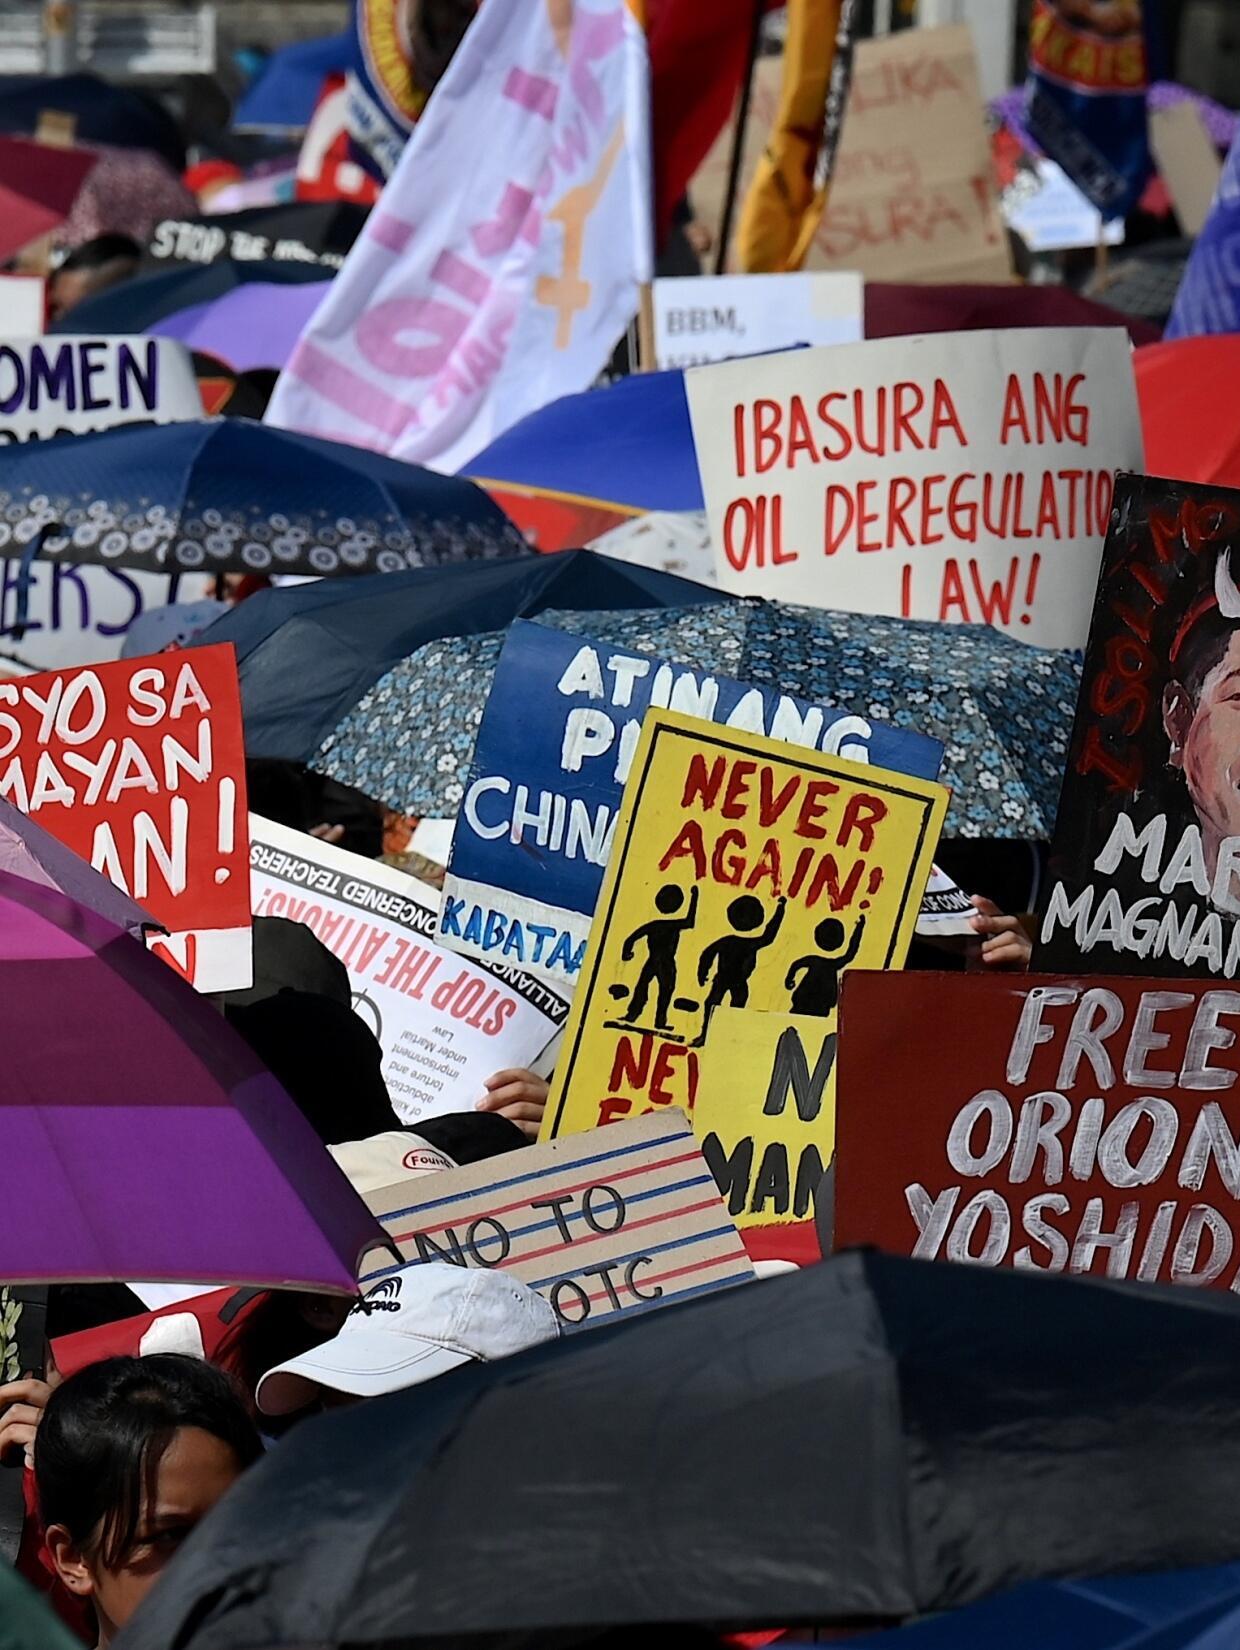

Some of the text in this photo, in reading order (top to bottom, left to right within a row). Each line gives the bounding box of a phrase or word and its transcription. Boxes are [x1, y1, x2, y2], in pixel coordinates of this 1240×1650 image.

[734, 372, 1089, 477] IBASURA ANG
[723, 468, 1113, 571] OIL DEREGULATIO
[127, 662, 212, 727] SA
[680, 753, 889, 852] NEVER
[250, 842, 342, 893] TEACHERS
[658, 820, 884, 912] AGAIN!
[374, 939, 443, 1001] THE
[429, 970, 517, 1037] STOP
[431, 1024, 455, 1043] Law
[388, 1059, 444, 1092] torture and
[390, 1043, 460, 1081] imprisonment
[400, 1030, 468, 1065] under Martial
[414, 1185, 626, 1268] NO TO
